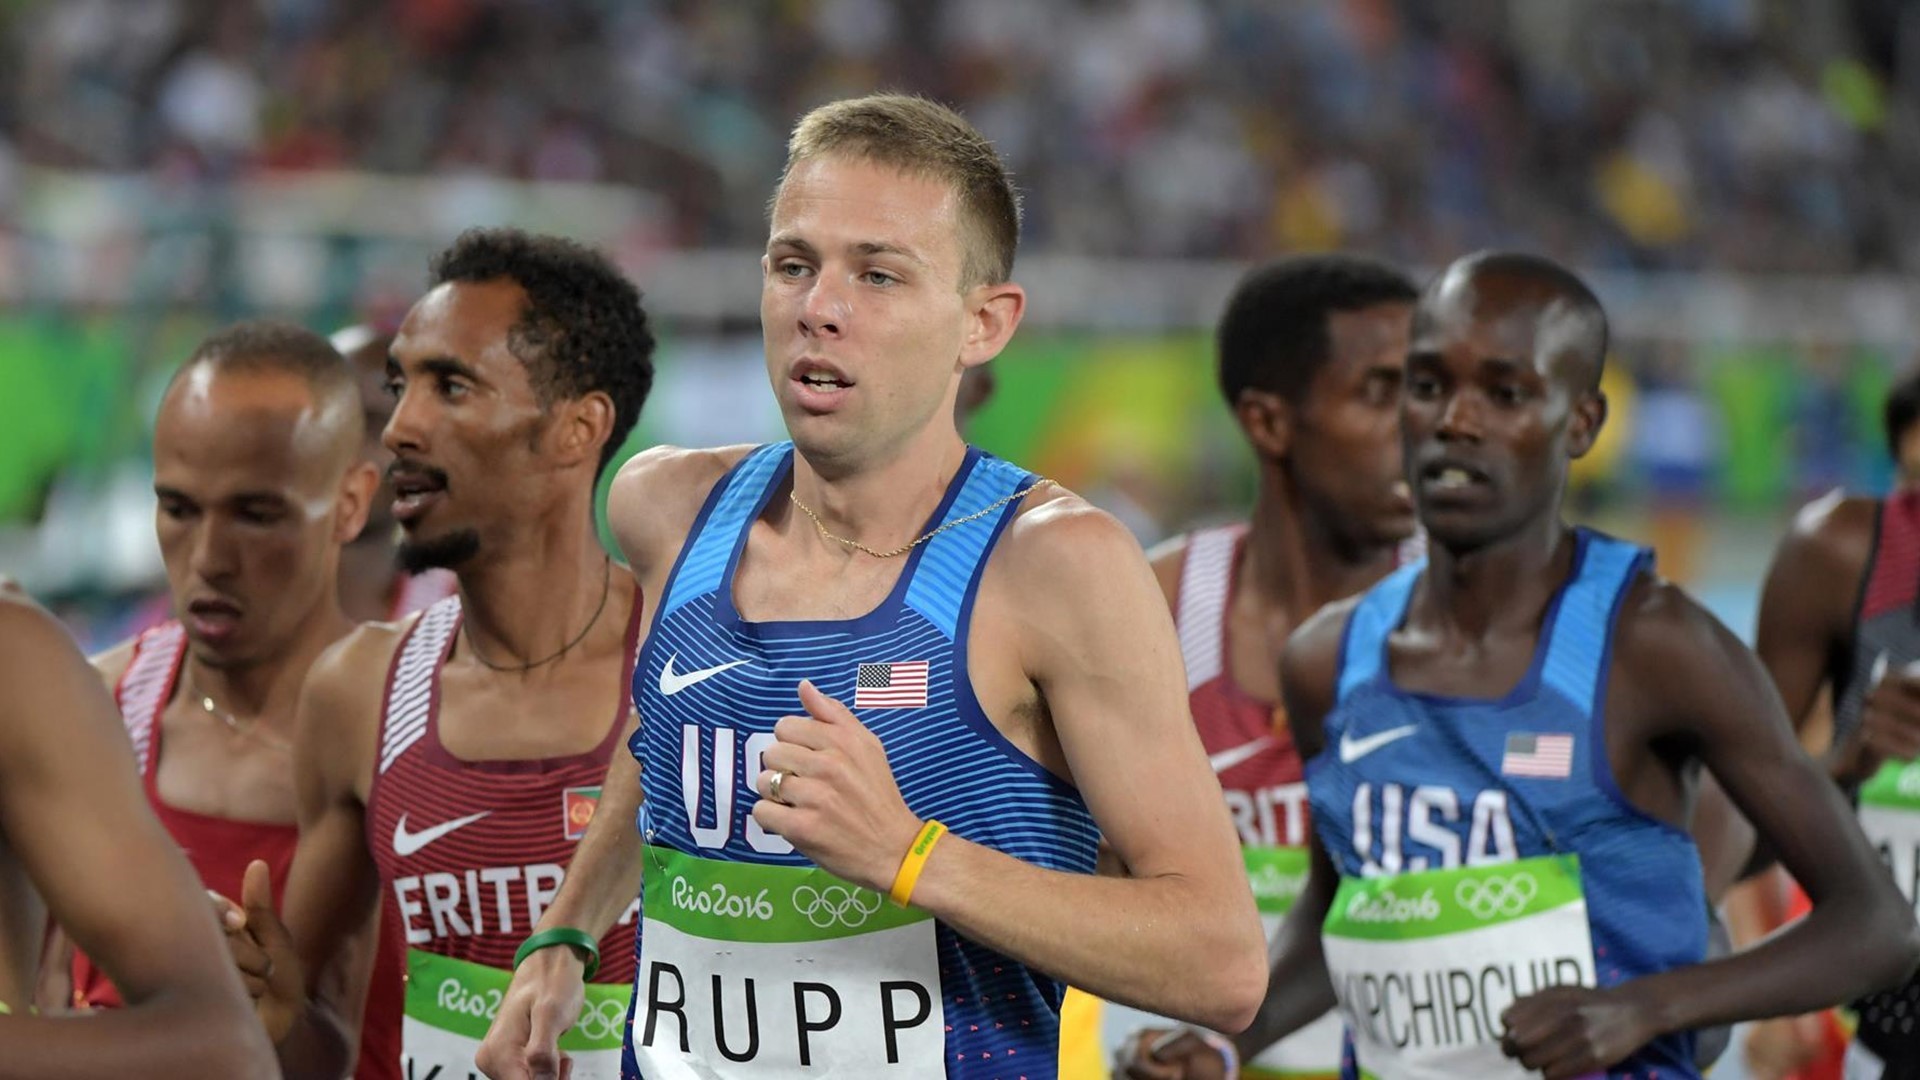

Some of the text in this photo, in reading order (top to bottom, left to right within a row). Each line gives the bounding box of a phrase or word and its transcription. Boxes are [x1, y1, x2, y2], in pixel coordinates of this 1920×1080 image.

[682, 724, 795, 854] US
[1353, 783, 1519, 879] USA
[393, 863, 641, 943] ERITR
[672, 875, 773, 920] Rio2016
[437, 978, 503, 1020] Rio2
[642, 960, 931, 1066] RUPP
